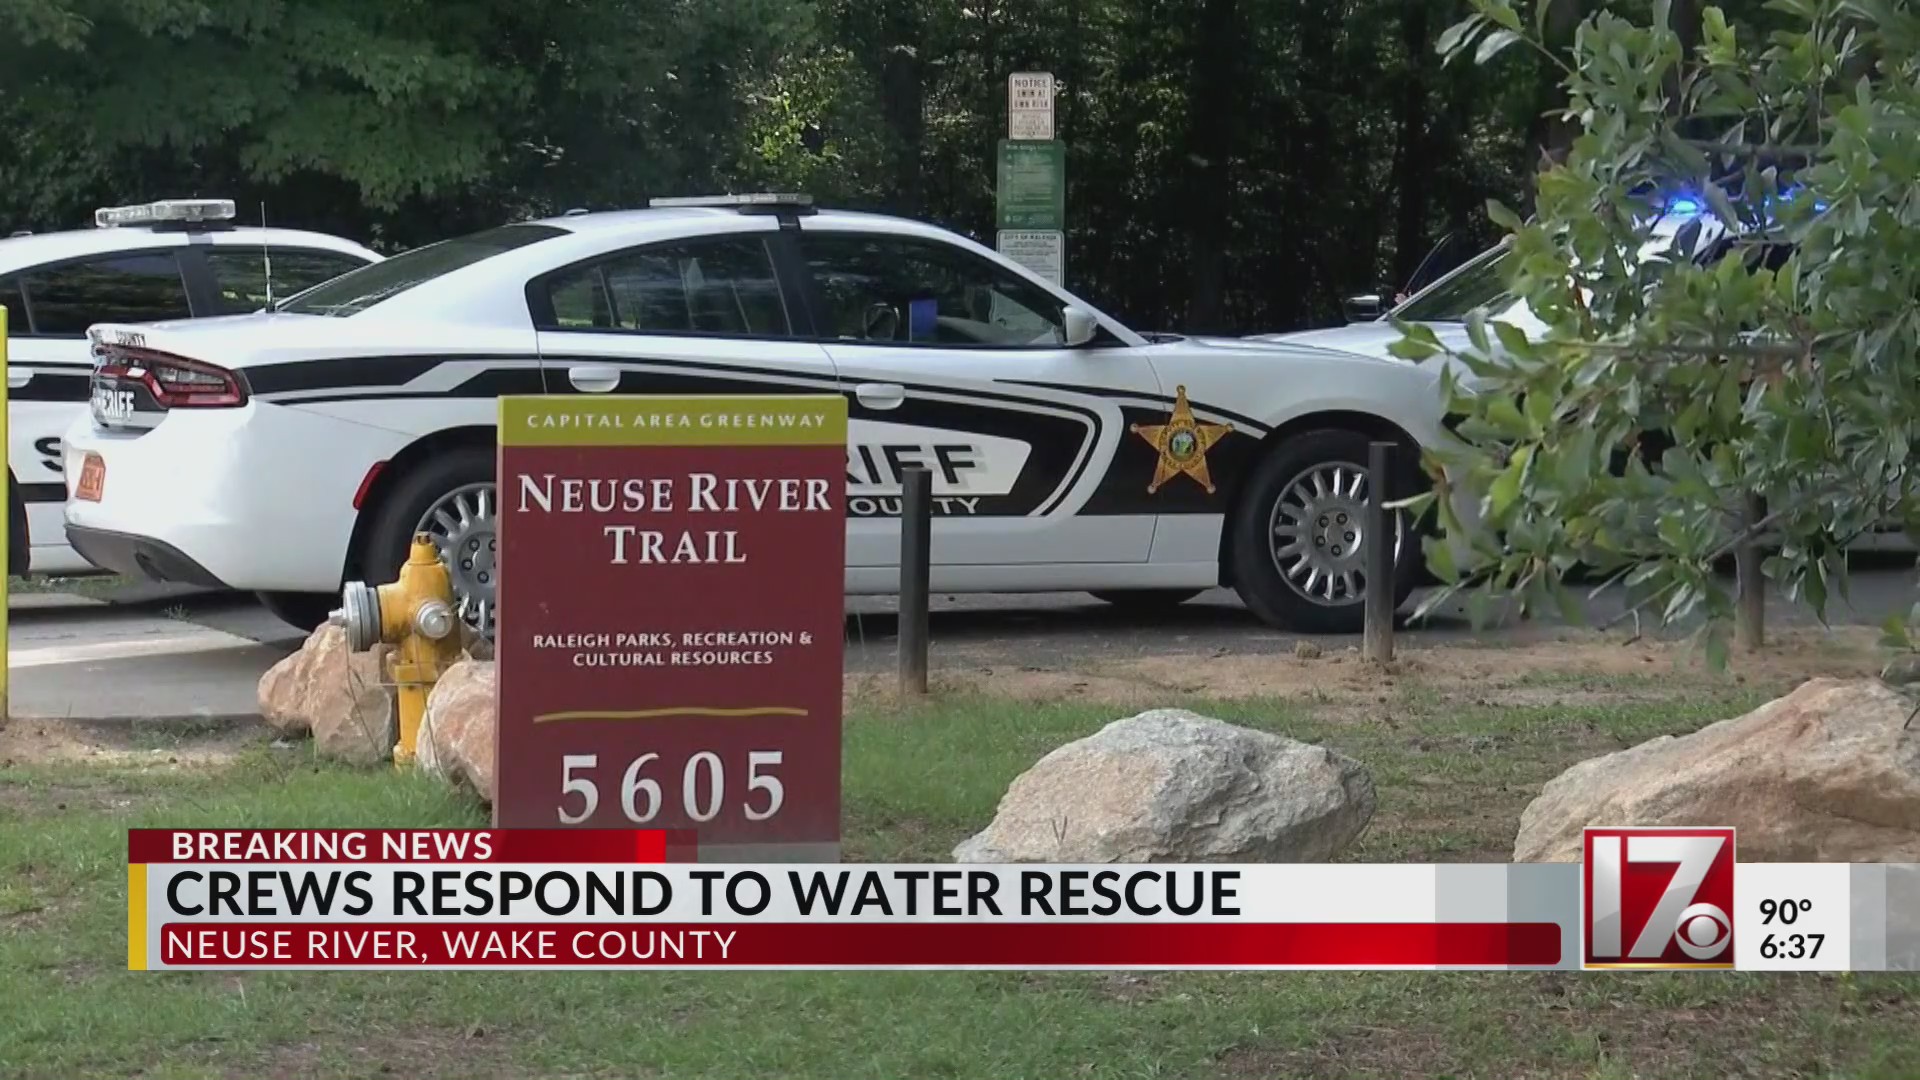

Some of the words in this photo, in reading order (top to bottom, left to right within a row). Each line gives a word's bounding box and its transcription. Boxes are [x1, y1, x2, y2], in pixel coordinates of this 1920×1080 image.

[527, 414, 624, 428] CAPITAL
[633, 413, 691, 427] AREA
[699, 414, 825, 428] GREENWAY
[517, 474, 673, 513] NEUSE
[688, 473, 832, 512] RIVER
[603, 525, 747, 564] TRAIL
[533, 633, 610, 648] RALEIGH
[616, 632, 677, 648] PARKS,
[682, 631, 793, 646] RECREATION
[799, 631, 812, 645] &
[572, 652, 665, 667] CULTURAL
[671, 650, 773, 666] RESOURCES
[557, 751, 784, 824] 5605
